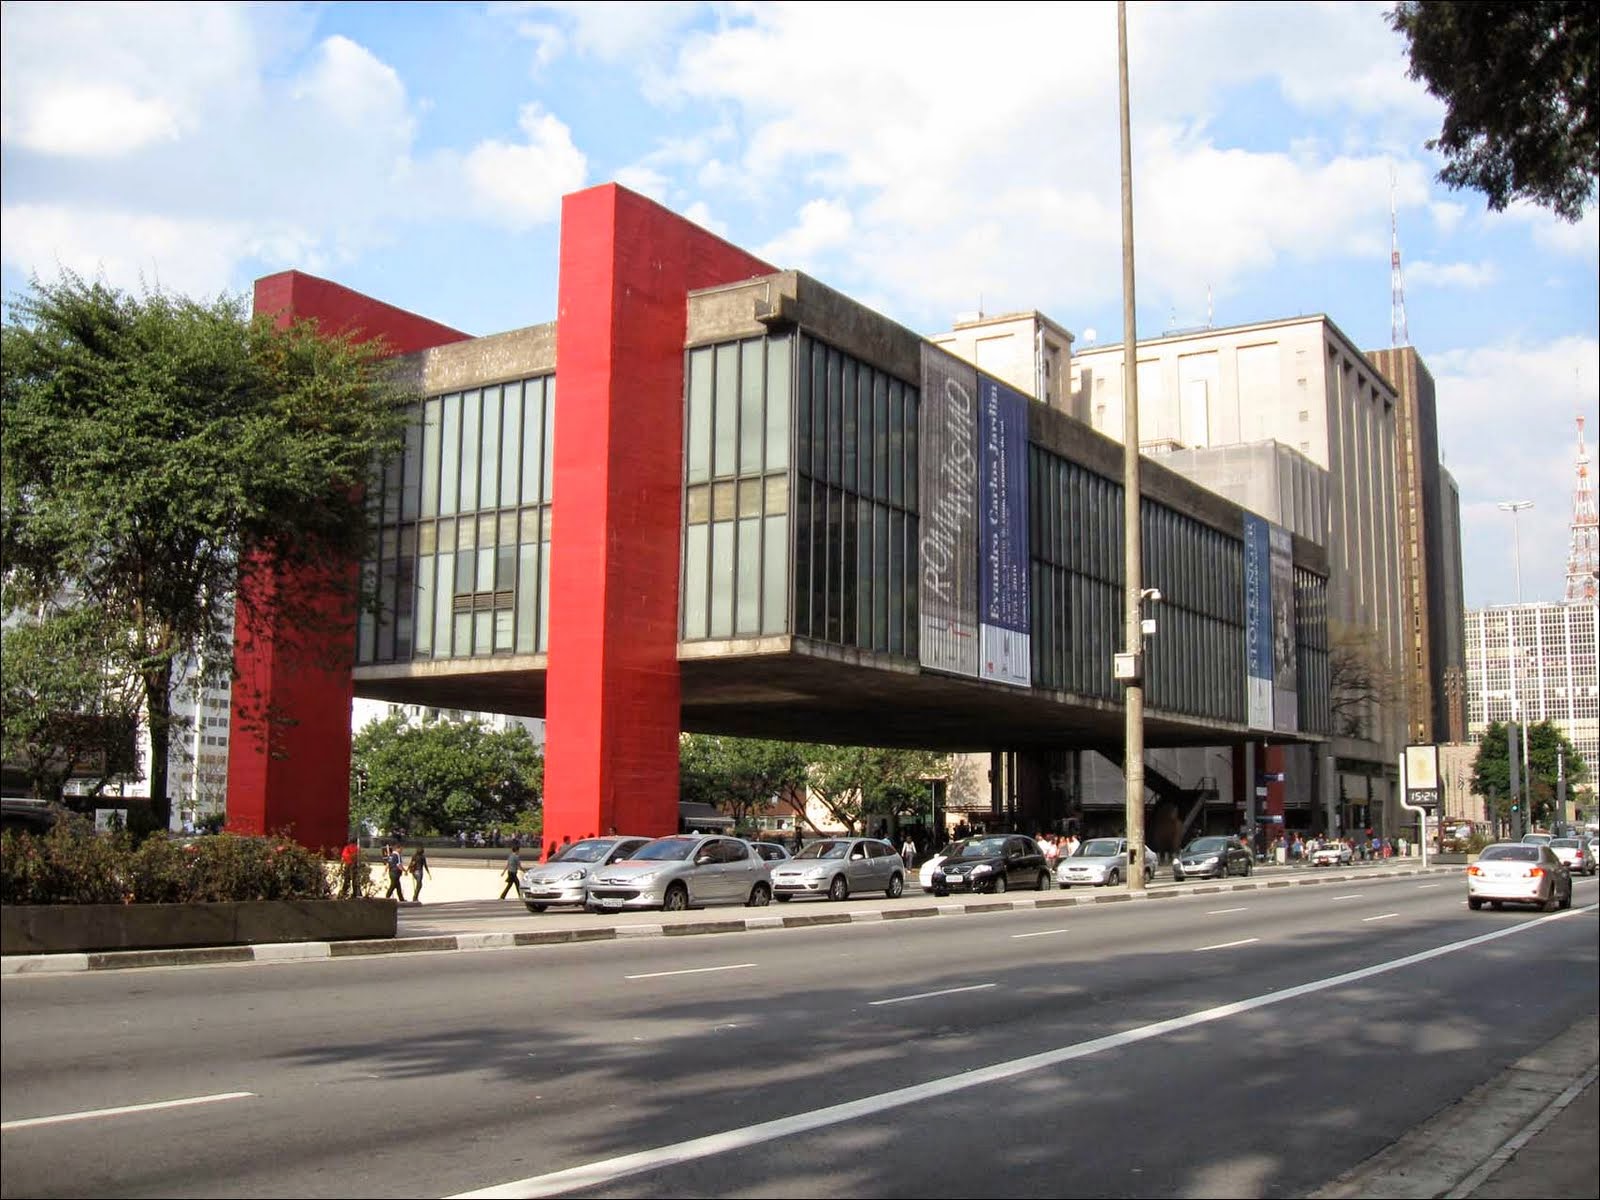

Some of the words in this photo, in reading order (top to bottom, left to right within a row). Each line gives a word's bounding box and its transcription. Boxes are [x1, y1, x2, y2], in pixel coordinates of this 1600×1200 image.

[988, 385, 999, 456] Jardim
[921, 378, 975, 602] ROMANTISMO
[988, 461, 999, 525] Carlos
[989, 533, 1000, 619] Evandro
[1411, 791, 1438, 801] 15:24
